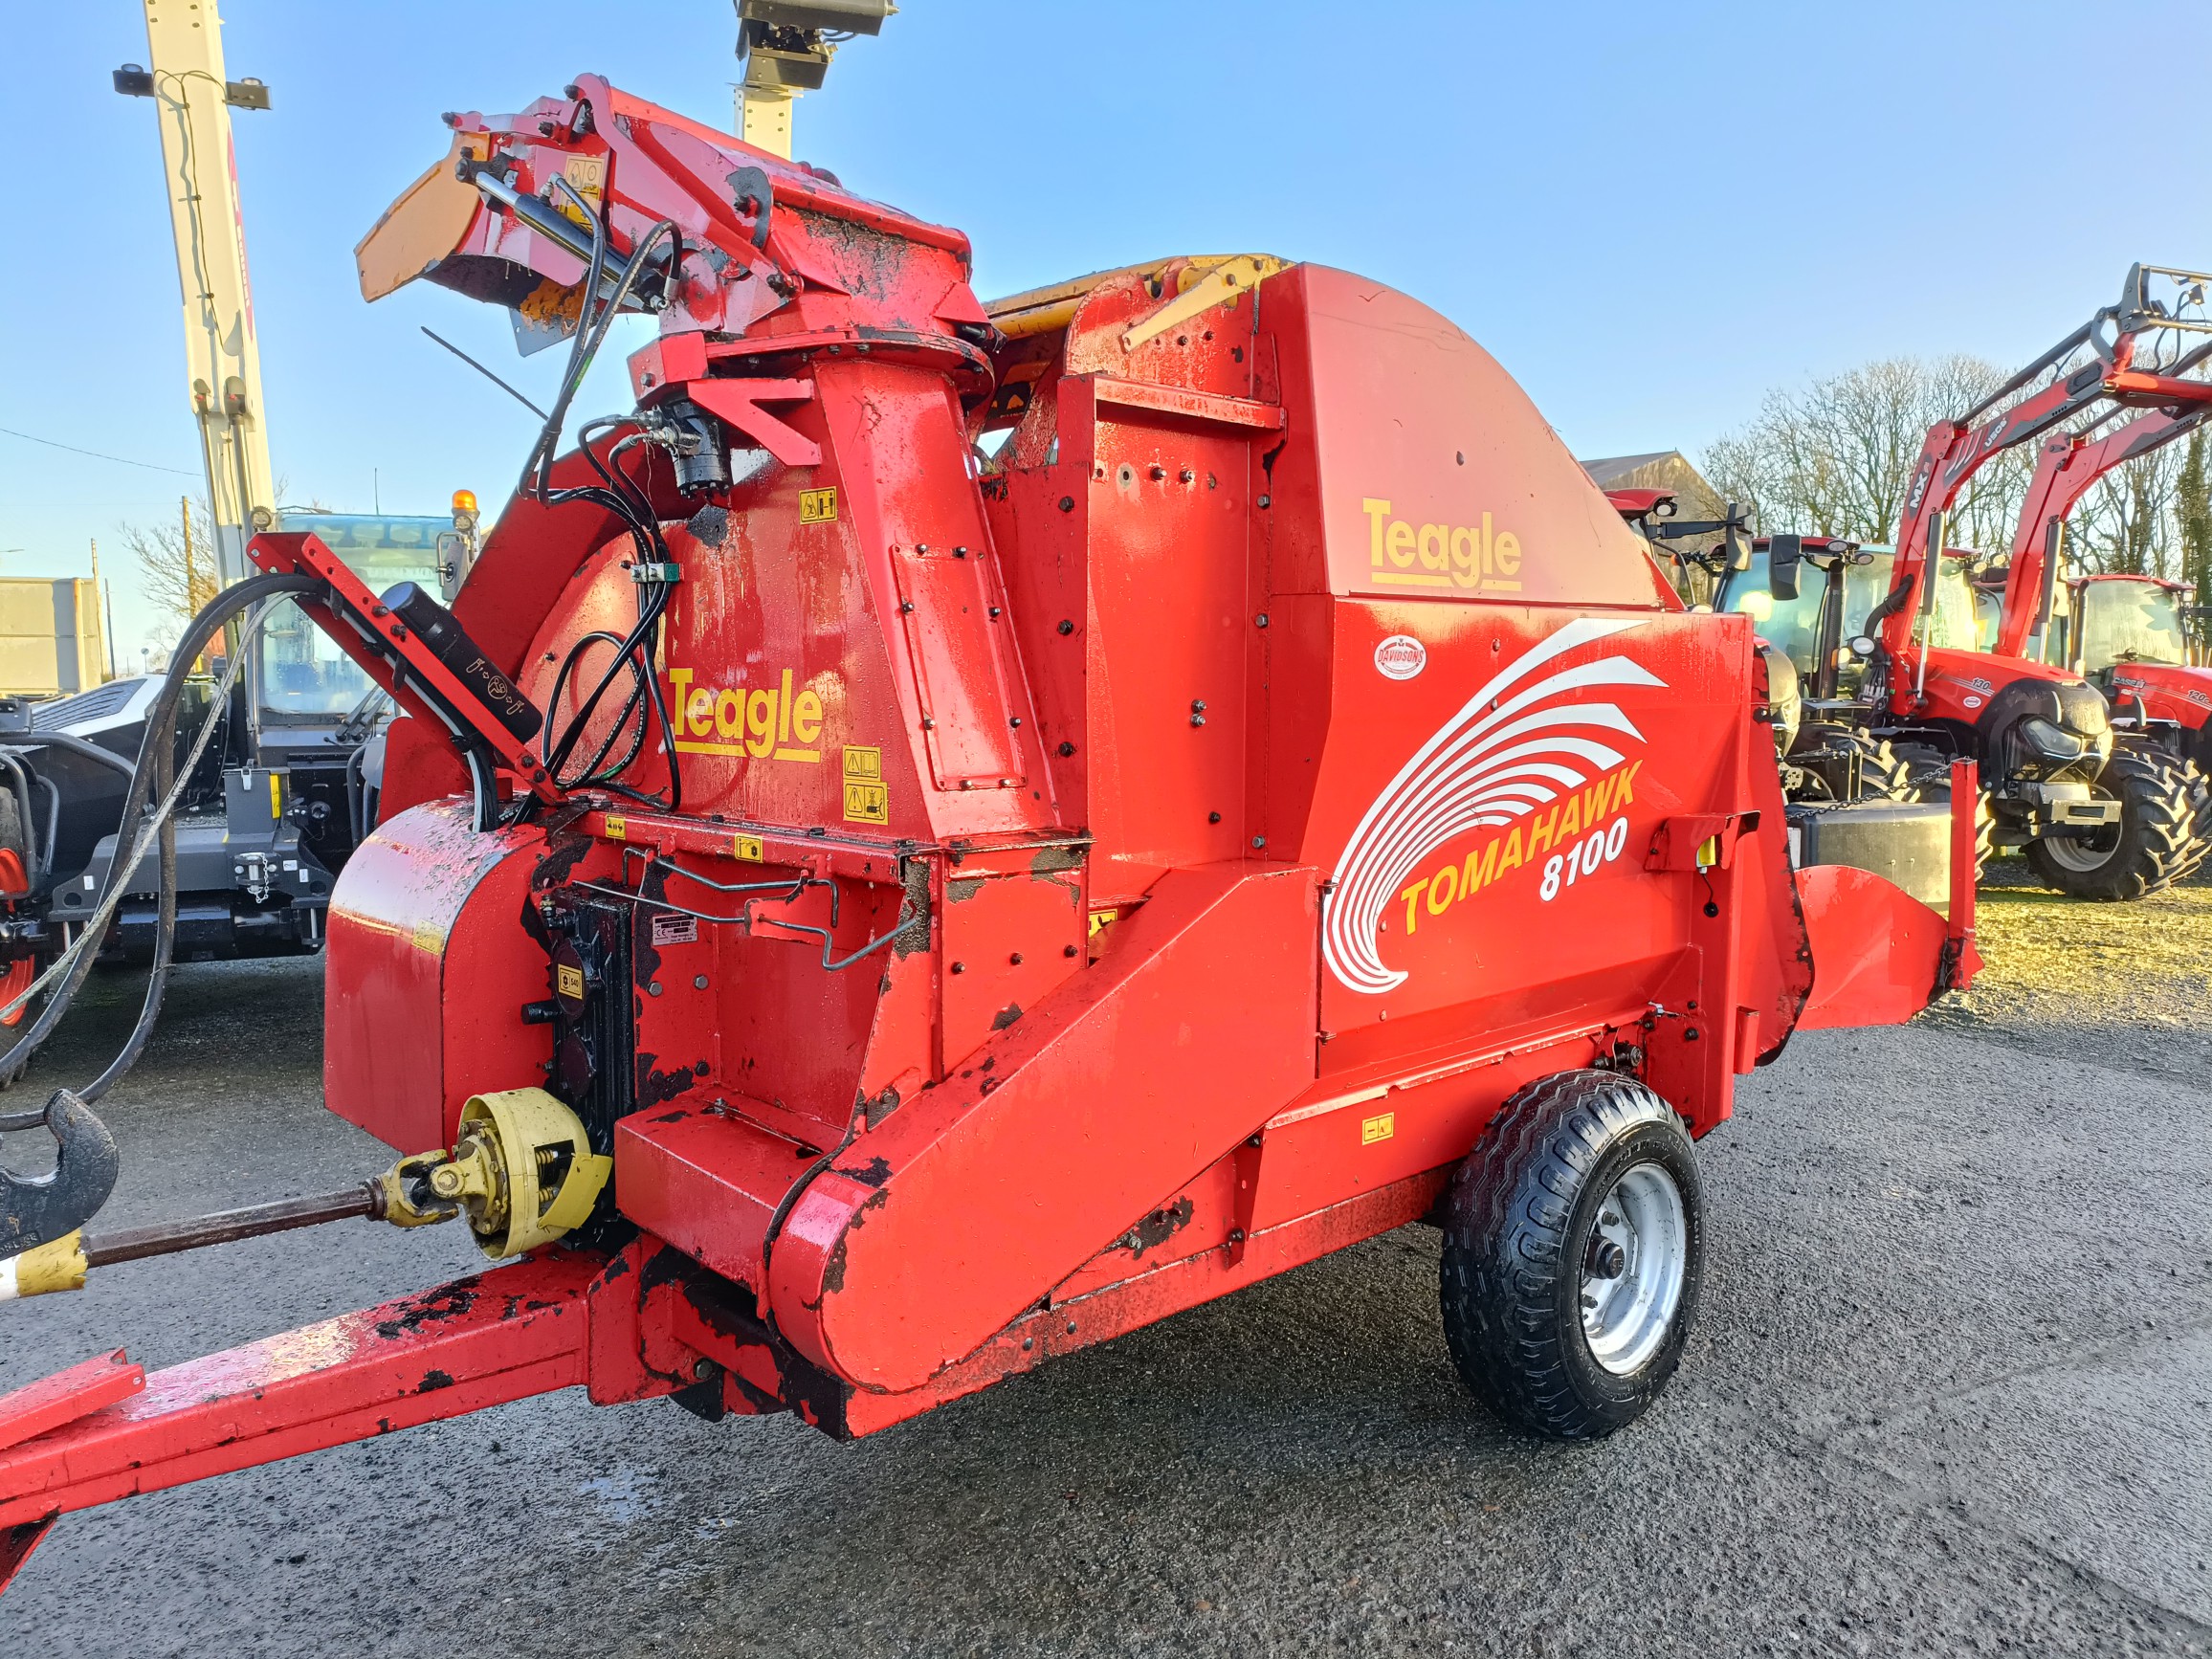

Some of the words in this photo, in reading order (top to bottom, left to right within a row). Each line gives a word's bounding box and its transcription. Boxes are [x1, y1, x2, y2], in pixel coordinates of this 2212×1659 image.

[1910, 474, 1929, 508] MX
[1362, 498, 1521, 588] Teagle
[1378, 649, 1425, 663] DAVIDSONS
[1973, 677, 1991, 690] 130
[669, 668, 823, 759] Teagle
[1401, 759, 1644, 936] TOMAHAWK
[1539, 816, 1628, 902] 8100
